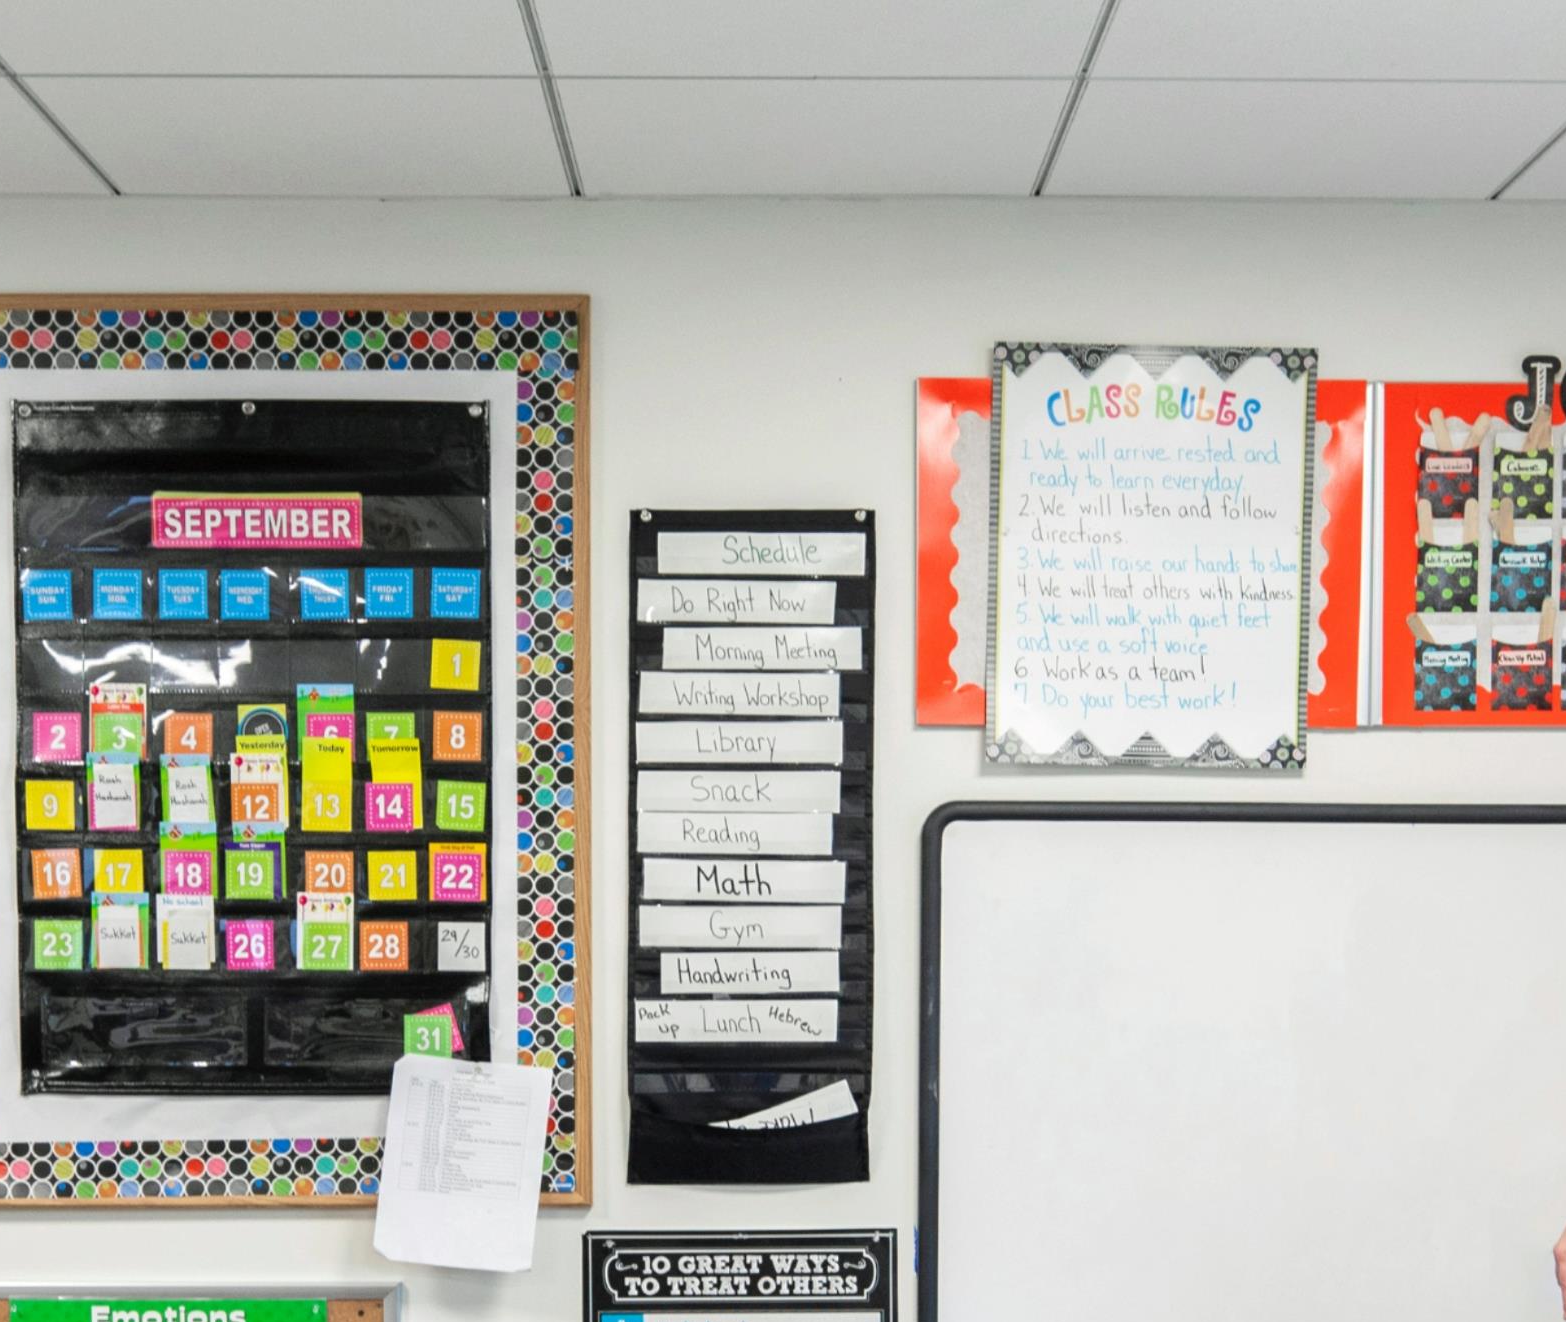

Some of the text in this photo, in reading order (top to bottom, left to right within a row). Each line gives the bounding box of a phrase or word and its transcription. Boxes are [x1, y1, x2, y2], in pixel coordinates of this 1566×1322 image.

[1047, 385, 1261, 431] CLASS RULES
[1040, 436, 1279, 464] We will arrive rested and
[1031, 470, 1077, 495] ready
[1087, 470, 1102, 488] to
[1110, 466, 1153, 489] learn
[1041, 492, 1276, 520] We will listen and follow
[163, 506, 352, 542] SEPTEMBER
[723, 535, 821, 564] Schedule
[672, 586, 805, 621] Do Right Now
[452, 653, 461, 677] 1
[696, 634, 837, 671] Morning Meeting
[1043, 656, 1206, 681] Work as a team!
[674, 680, 829, 711] Writing Workshop
[51, 726, 66, 750] 2
[181, 728, 197, 750] 4
[239, 740, 286, 752] Yesterday
[318, 743, 345, 756] Today
[371, 743, 419, 755] Tomorrow
[450, 725, 465, 749] 8
[697, 726, 776, 761] Library
[691, 774, 772, 802] Snack
[242, 796, 270, 820] 12
[375, 794, 404, 819] 14
[447, 794, 474, 818] 15
[682, 816, 760, 850] Reading
[175, 862, 202, 887] 18
[237, 862, 263, 887] 19
[442, 863, 474, 890] 22
[697, 864, 771, 895] Math
[170, 929, 207, 947] Sukkot
[710, 910, 764, 945] Gym
[233, 933, 265, 959] 26
[368, 934, 399, 959] 28
[678, 958, 791, 989] Handwriting
[703, 1005, 761, 1033] Lunch
[769, 1006, 821, 1035] Hebrew
[416, 1026, 442, 1051] 31
[643, 1254, 840, 1276] 10 GREAT WAYS
[625, 1276, 858, 1296] TO TREAT OTHERS
